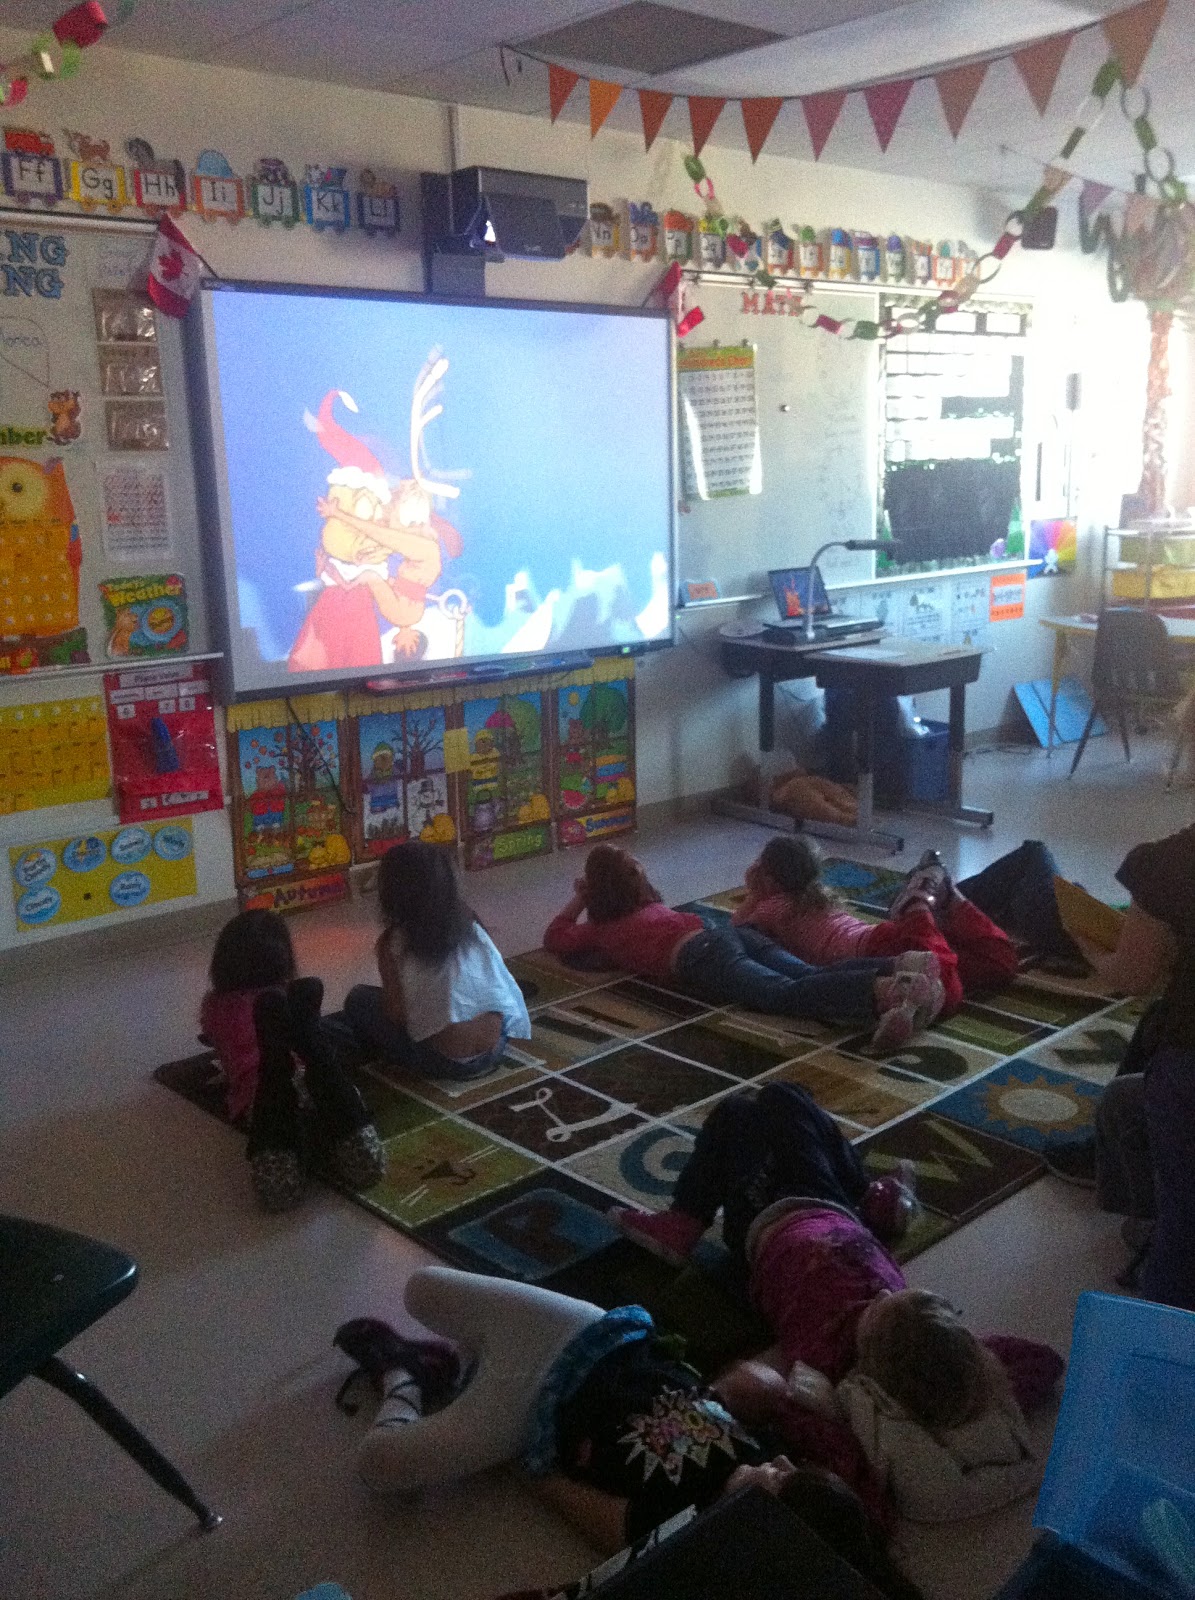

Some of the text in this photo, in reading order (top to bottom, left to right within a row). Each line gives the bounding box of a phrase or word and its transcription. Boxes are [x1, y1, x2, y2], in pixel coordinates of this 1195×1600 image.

[18, 163, 45, 184] Ff
[81, 169, 114, 201] Gg
[144, 171, 175, 197] Hh
[262, 185, 284, 216] Jj
[315, 190, 341, 213] Kk
[0, 229, 69, 267] NG
[108, 582, 181, 607] Weather
[498, 832, 543, 853] Spring
